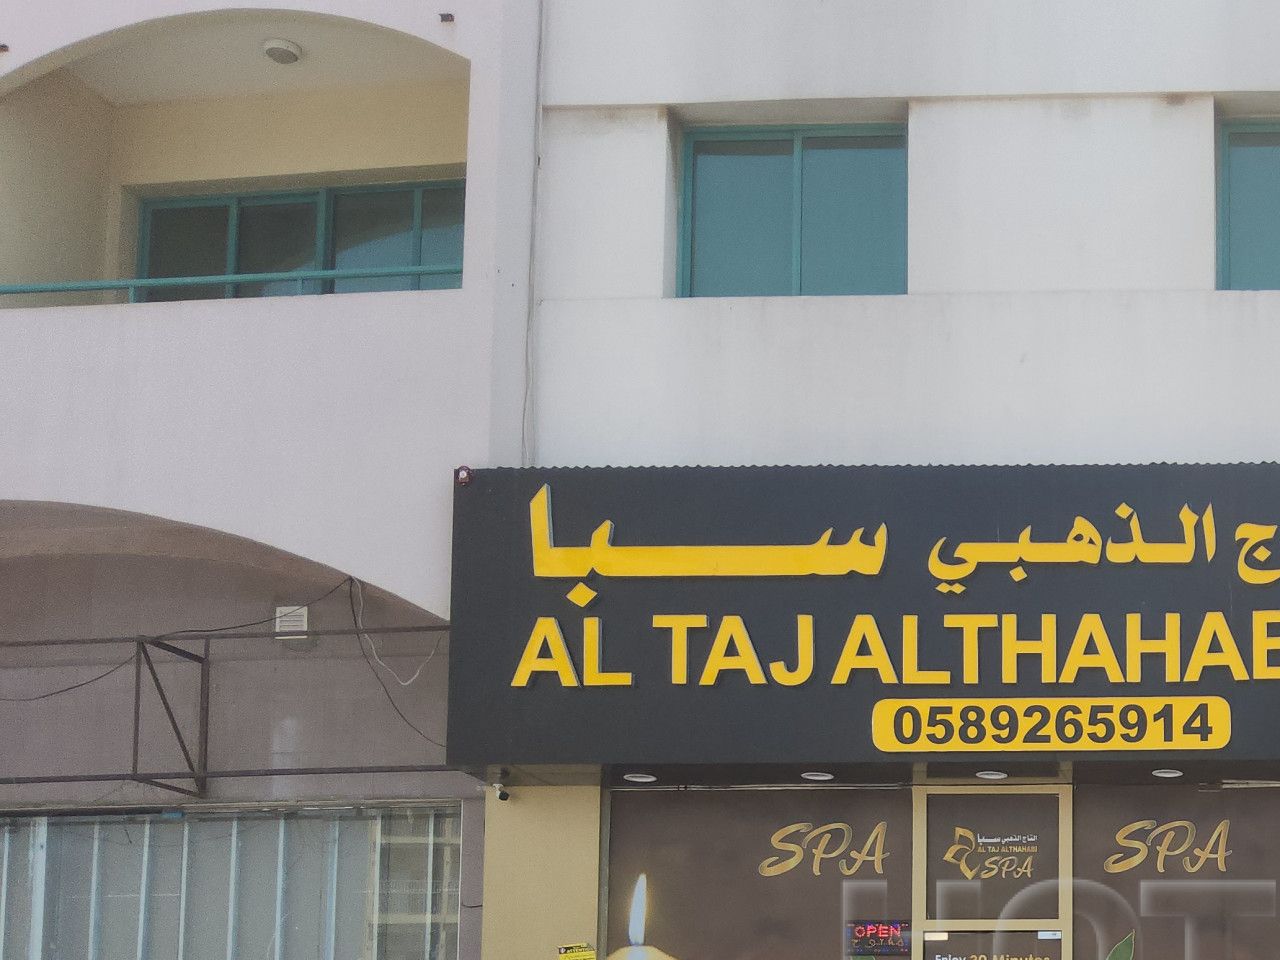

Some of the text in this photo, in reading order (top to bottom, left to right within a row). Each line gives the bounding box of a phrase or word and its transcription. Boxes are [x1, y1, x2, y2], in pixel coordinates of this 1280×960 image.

[530, 483, 888, 608] سبا
[928, 501, 1218, 595] الذهبي
[511, 614, 633, 688] AL
[652, 614, 814, 687] TAJ
[893, 702, 1213, 747] 0589265914
[758, 821, 890, 877] SPA
[981, 855, 1034, 878] SPA
[1103, 819, 1232, 876] SPA
[855, 924, 901, 938] OPEN
